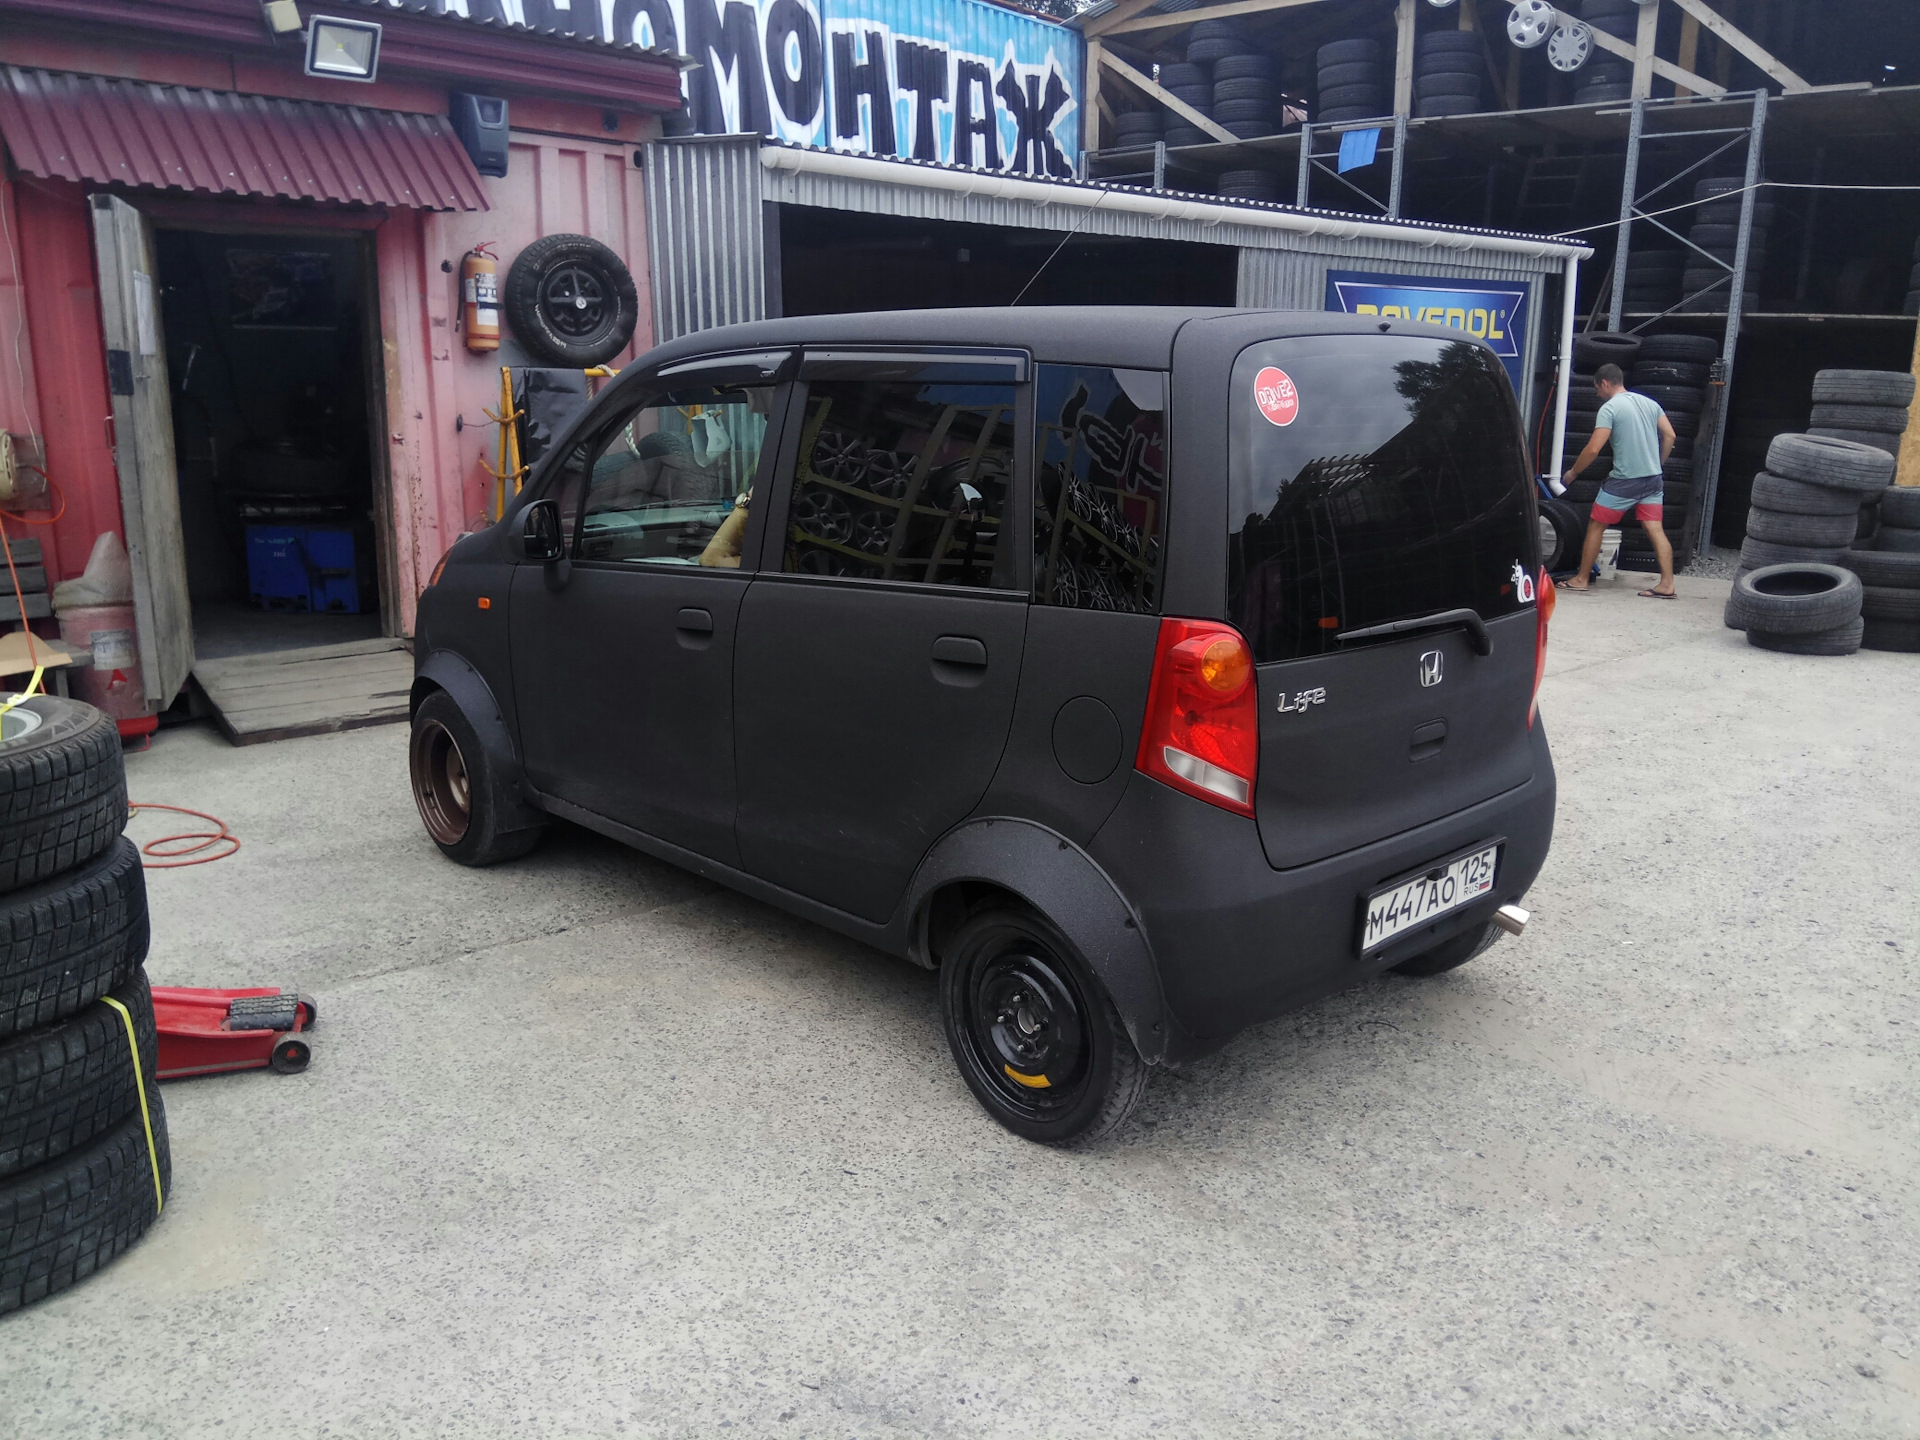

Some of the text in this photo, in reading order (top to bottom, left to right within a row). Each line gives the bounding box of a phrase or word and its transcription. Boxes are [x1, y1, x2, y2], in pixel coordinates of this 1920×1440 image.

[400, 0, 1073, 179] МОНТАЖ
[1258, 379, 1294, 405] DRIVE2
[1277, 687, 1327, 713] Life
[1460, 851, 1491, 886] 125
[1463, 880, 1479, 897] RUS
